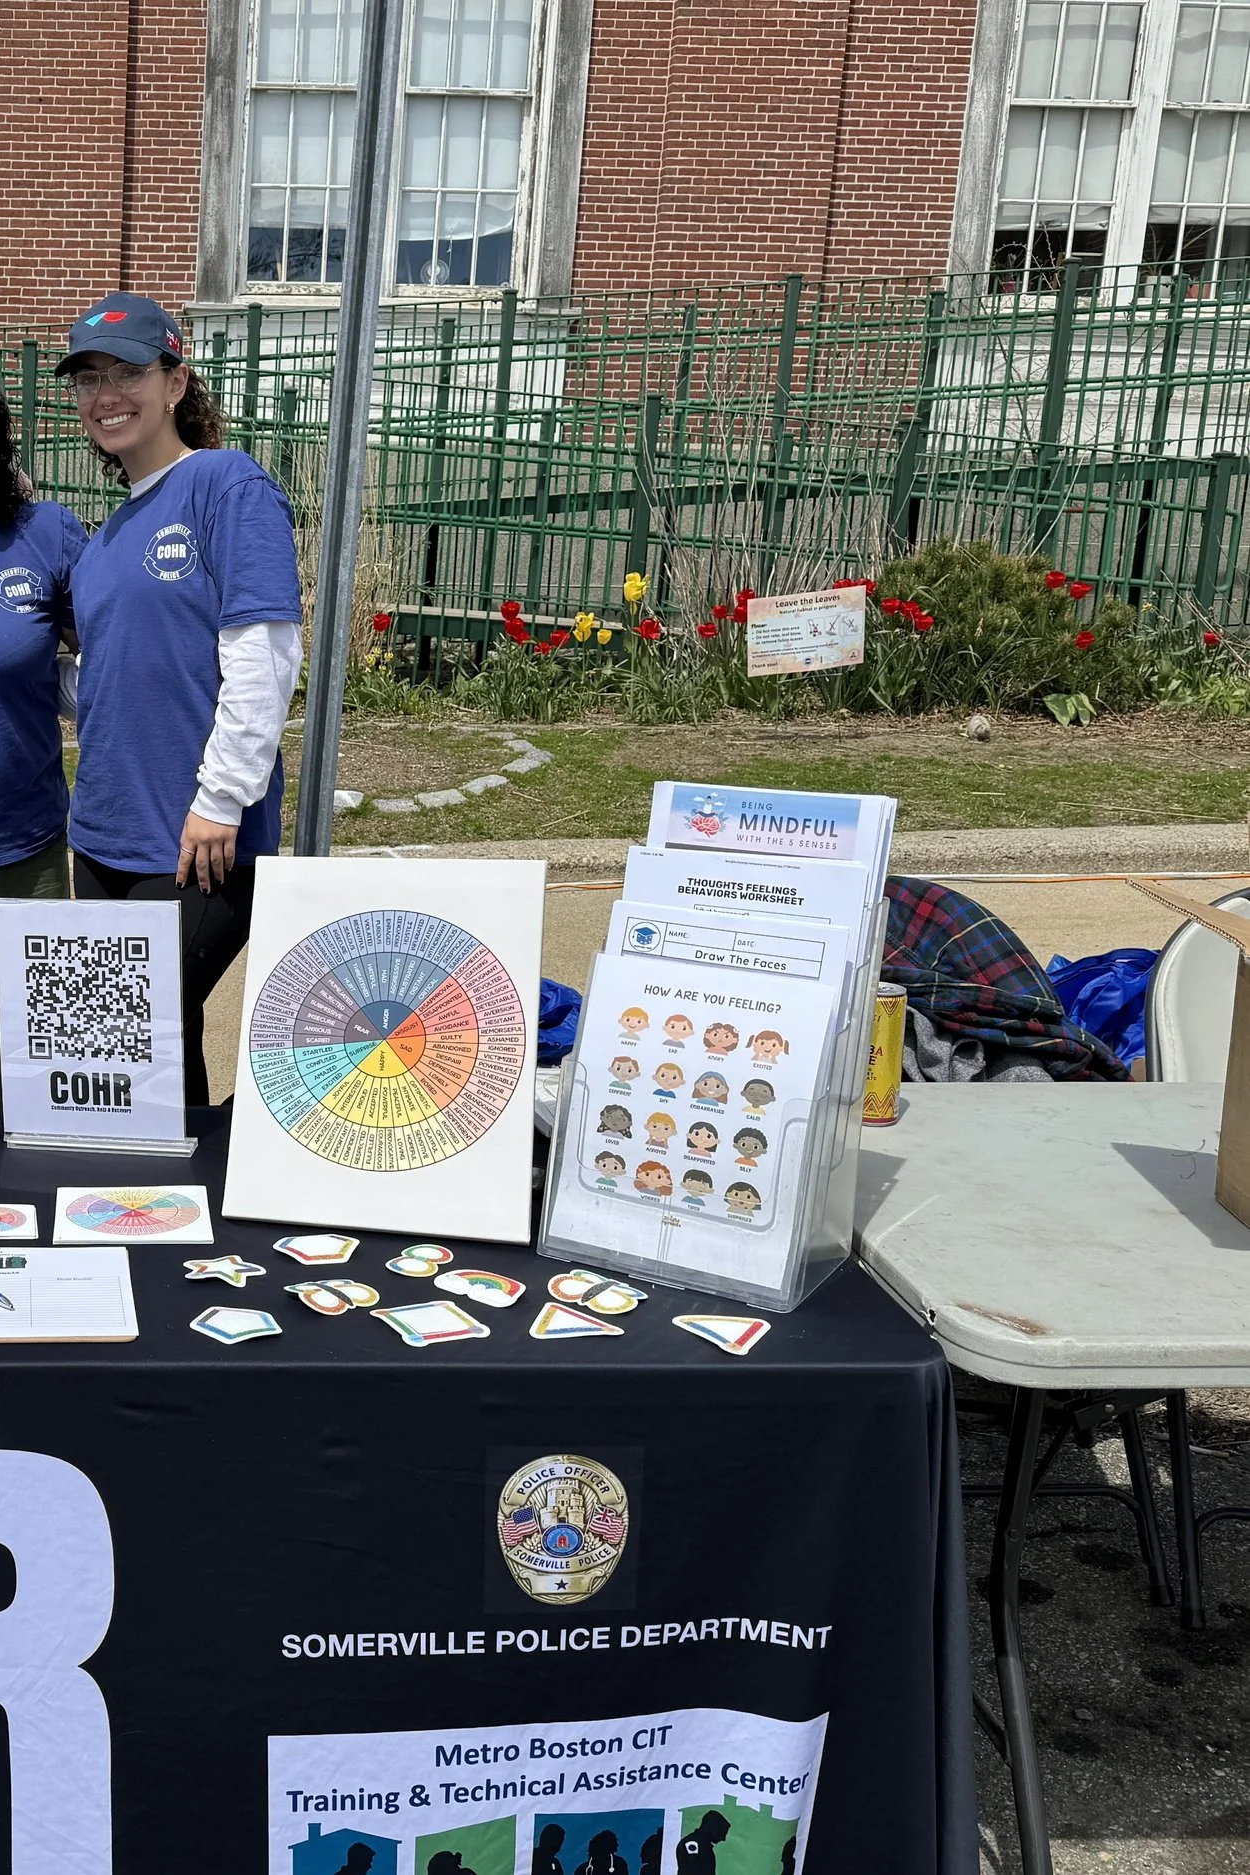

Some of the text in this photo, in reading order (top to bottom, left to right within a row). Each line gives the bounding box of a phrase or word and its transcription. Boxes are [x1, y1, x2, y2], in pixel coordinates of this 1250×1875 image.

[157, 544, 186, 559] COHR
[4, 582, 32, 598] COHR
[776, 600, 798, 608] Leave
[742, 801, 773, 811] BEING
[738, 813, 838, 838] MINDFUL
[736, 834, 762, 843] WITH
[767, 837, 784, 845] THE
[799, 840, 837, 850] SENSES
[677, 885, 805, 906] BEHAVIORS WORKSHEET
[687, 877, 797, 896] THOUGHTS FEELINGS
[668, 930, 690, 939] NAME:
[737, 940, 757, 948] DATE:
[462, 959, 488, 980] LOATHING
[695, 950, 787, 971] Draw The Faces
[344, 977, 356, 992] HURT
[390, 958, 401, 995] AGGRESSIVE
[398, 960, 416, 996] FRUSTRATED
[409, 971, 425, 995] DISTANT
[465, 965, 498, 989] REPUGNANT
[472, 975, 503, 994] REVOLTED
[418, 979, 438, 1000] CRITICAL
[418, 982, 454, 1012] DISAPPROVAL
[475, 984, 509, 1002] REVULSION
[644, 984, 672, 997] HOW
[674, 989, 699, 1002] ARE
[703, 993, 725, 1005] YOU
[422, 992, 463, 1018] DISAPPOINTED
[476, 993, 515, 1011] DETESTABLE
[484, 1005, 515, 1017] AVERSION
[438, 1010, 460, 1021] AWFUL
[485, 1016, 516, 1026] HESITANT
[354, 1024, 370, 1036] FEAR
[394, 1022, 419, 1036] DISGUST
[434, 1020, 469, 1032] AVOIDANCE
[257, 1050, 286, 1059] SHOCKED
[302, 1046, 333, 1056] STARTLED
[349, 1042, 377, 1057] SURPRISE
[400, 1044, 413, 1052] SAD
[432, 1044, 472, 1053] ABANDONED
[258, 1058, 288, 1070] DISMAYED
[306, 1054, 337, 1069] CONFUSED
[436, 1053, 462, 1065] DESPAIR
[484, 1053, 518, 1064] VICTIMIZED
[314, 1065, 337, 1080] AMAZED
[428, 1060, 462, 1080] DEPRESSED
[478, 1061, 517, 1075] POWERLESS
[321, 1072, 343, 1091] EXCITED
[420, 1078, 438, 1095] BORED
[428, 1071, 449, 1088] LONELY
[475, 1069, 514, 1086] VULNERABLE
[50, 1071, 132, 1107] COHR
[332, 1081, 350, 1100] JOYFUL
[340, 1080, 362, 1112] INTERESTED
[409, 1080, 431, 1110] OPTIMISTIC
[356, 1088, 368, 1109] PROUD
[368, 1087, 378, 1118] ACCEPTED
[392, 1088, 402, 1118] PEACEFUL
[401, 1086, 416, 1112] INTIMATE
[516, 1466, 610, 1496] POLICE OFFICER
[513, 1547, 612, 1569] SOMERVILLE POLICE
[281, 1617, 833, 1659] SOMERVILLE POLICE DEPARTMENT
[435, 1724, 673, 1768] Metro Boston CIT
[287, 1760, 810, 1814] Training & Technical Assistance Center
